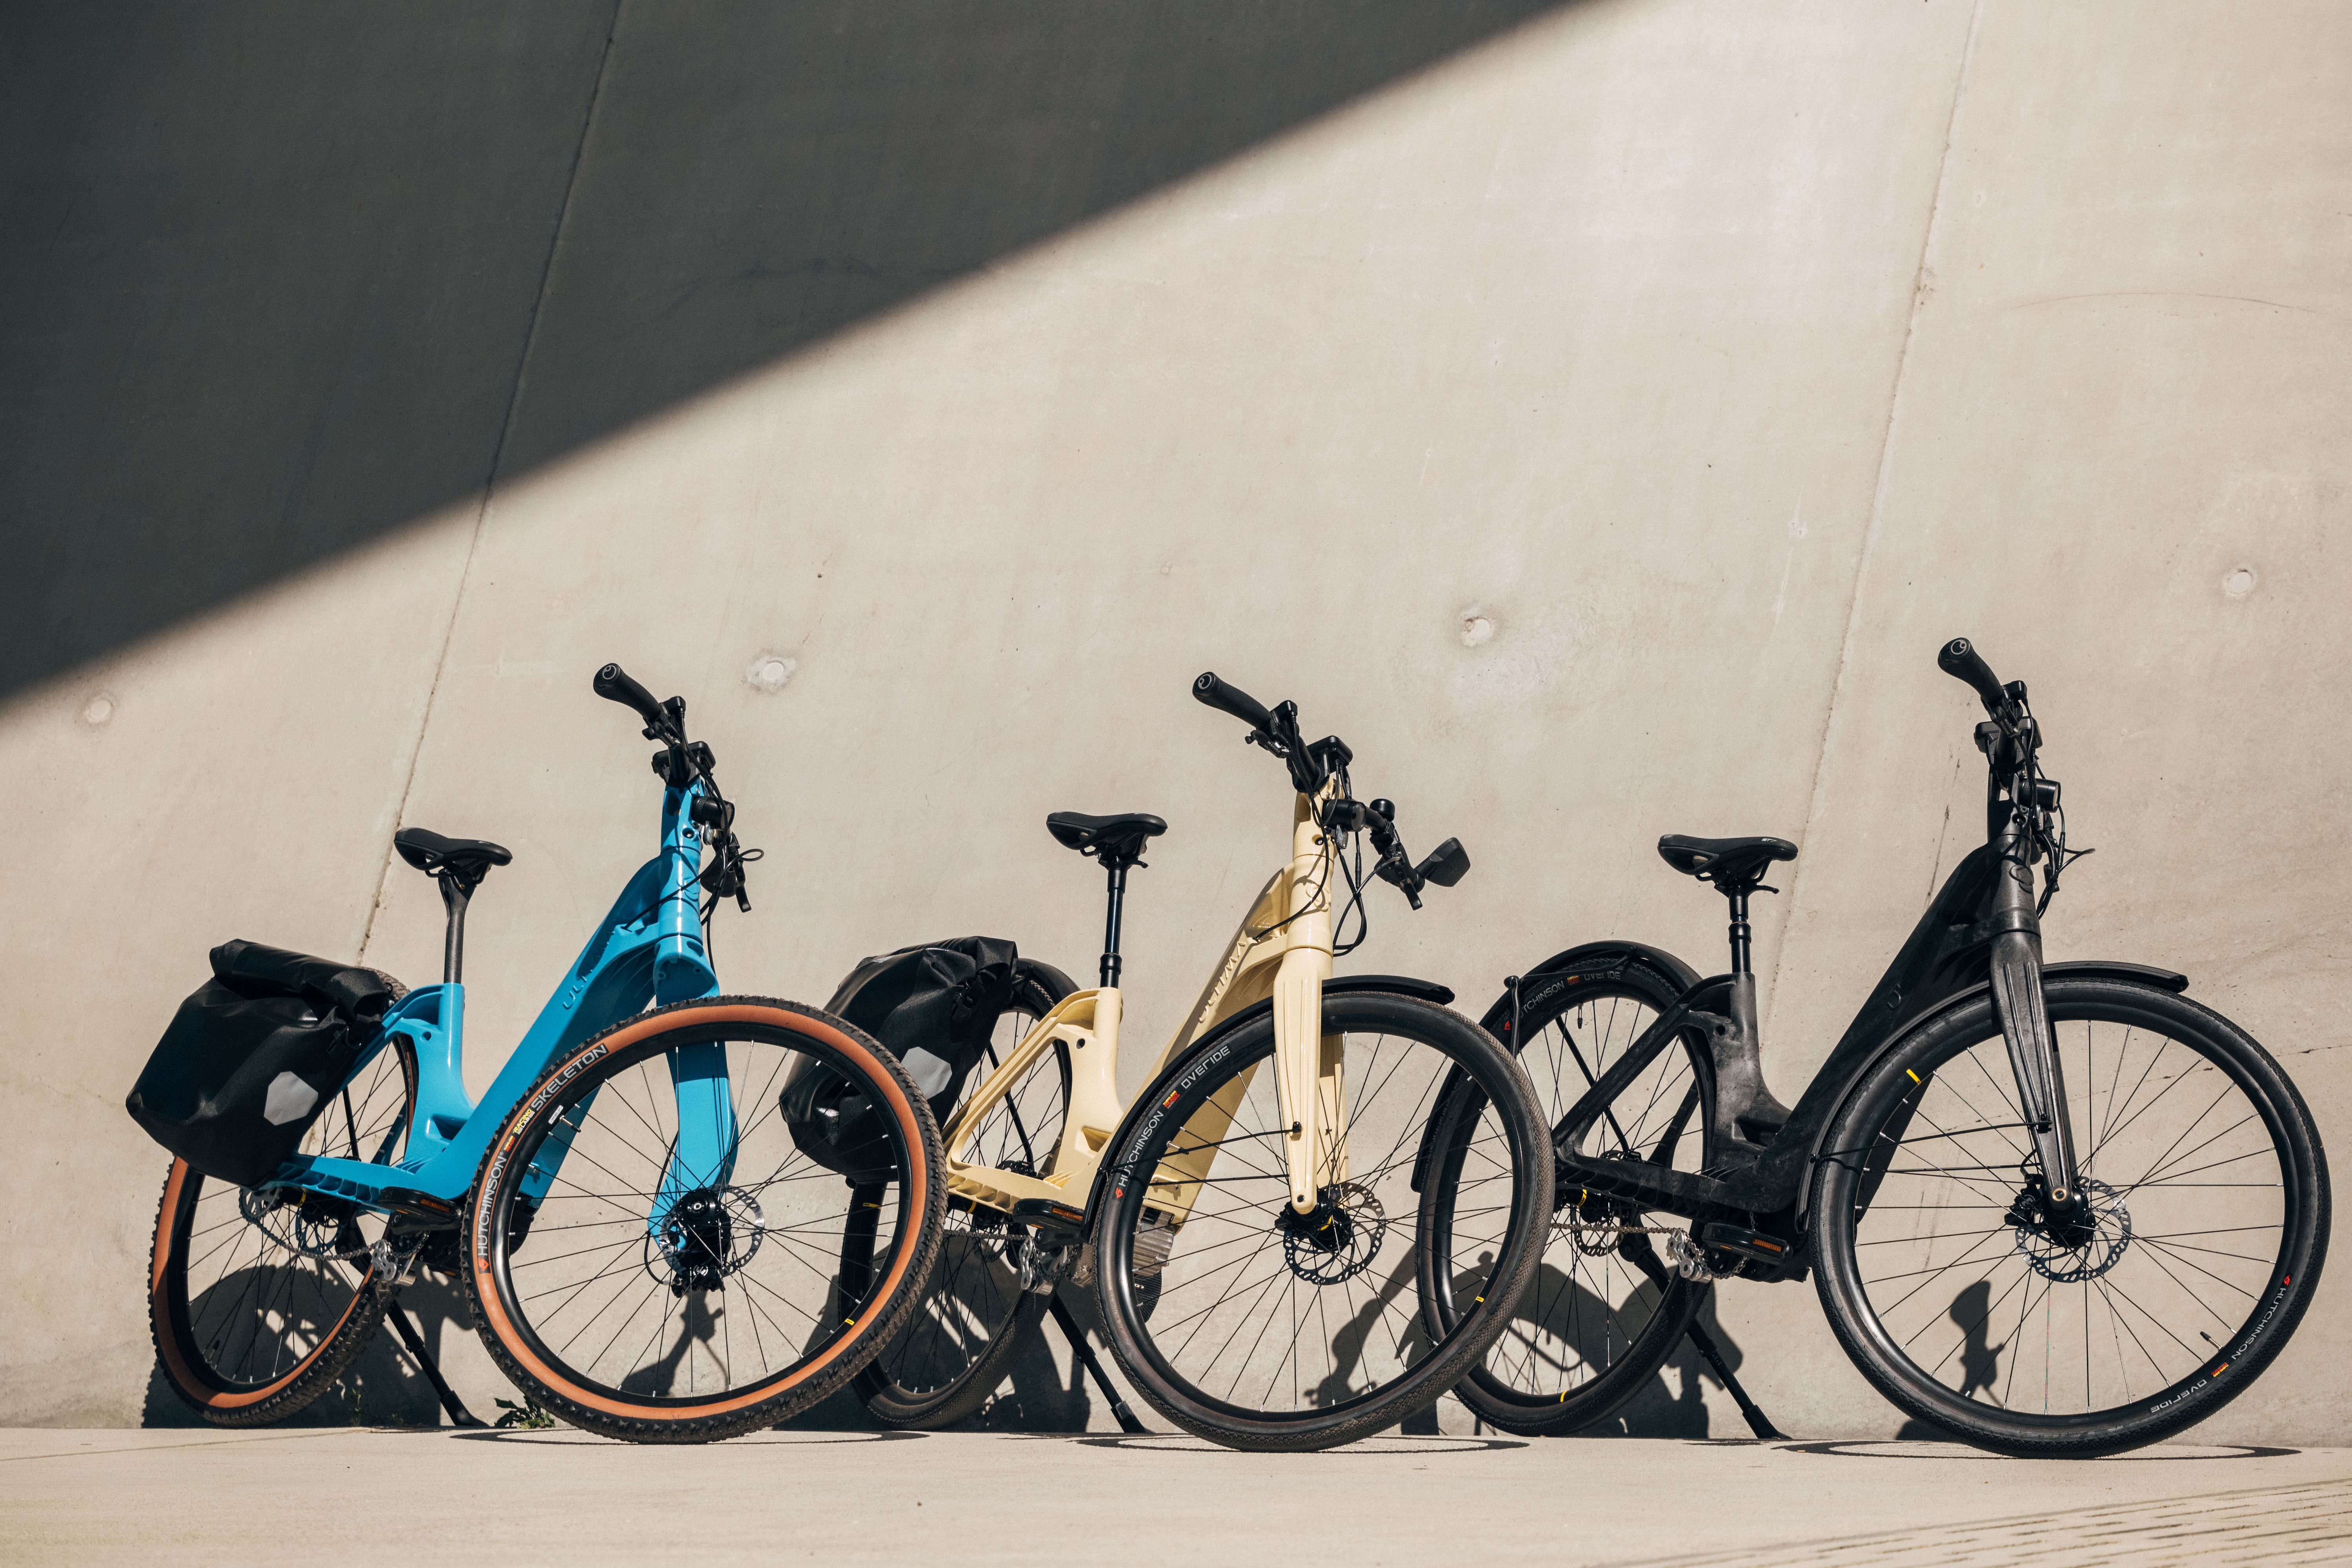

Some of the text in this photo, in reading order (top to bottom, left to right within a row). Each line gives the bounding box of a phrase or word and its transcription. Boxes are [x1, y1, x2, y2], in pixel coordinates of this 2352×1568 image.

[1512, 980, 1565, 1022] TCHINSON
[531, 1044, 608, 1111] SKELETON
[513, 1108, 532, 1133] RACING
[521, 1116, 531, 1128] LAB
[506, 1137, 516, 1152] READY
[2231, 1288, 2286, 1360] HUTCHINSON
